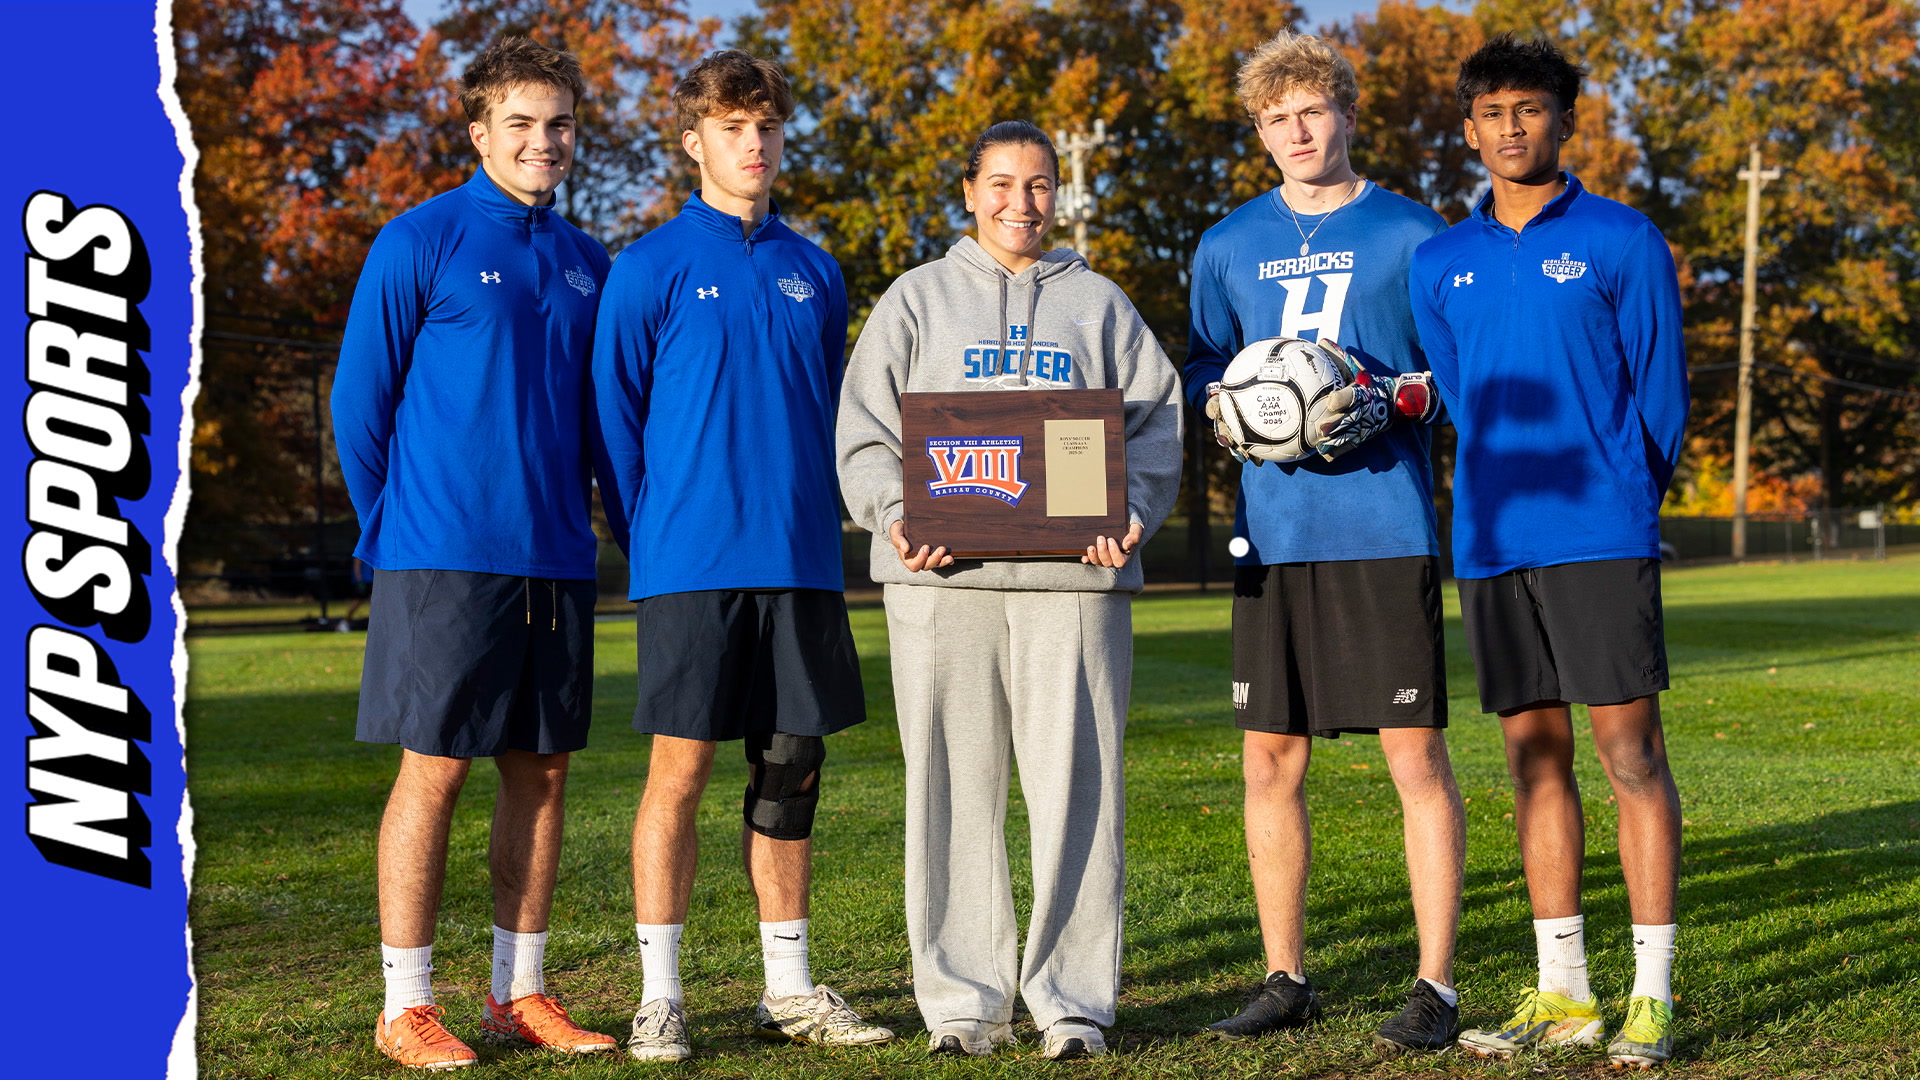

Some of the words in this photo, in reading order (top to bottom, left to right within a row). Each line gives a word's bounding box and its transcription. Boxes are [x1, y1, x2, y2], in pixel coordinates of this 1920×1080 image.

[1258, 251, 1354, 280] HERRICKS
[1545, 264, 1582, 277] SOCCER
[781, 283, 813, 297] SOCCER
[1276, 272, 1353, 345] H
[1008, 324, 1028, 340] H
[1012, 340, 1059, 348] HIGANDERS
[963, 347, 1072, 383] SOCCER
[928, 446, 1021, 484] VIII
[935, 487, 970, 496] NASSAU
[975, 488, 1013, 502] COUNTY
